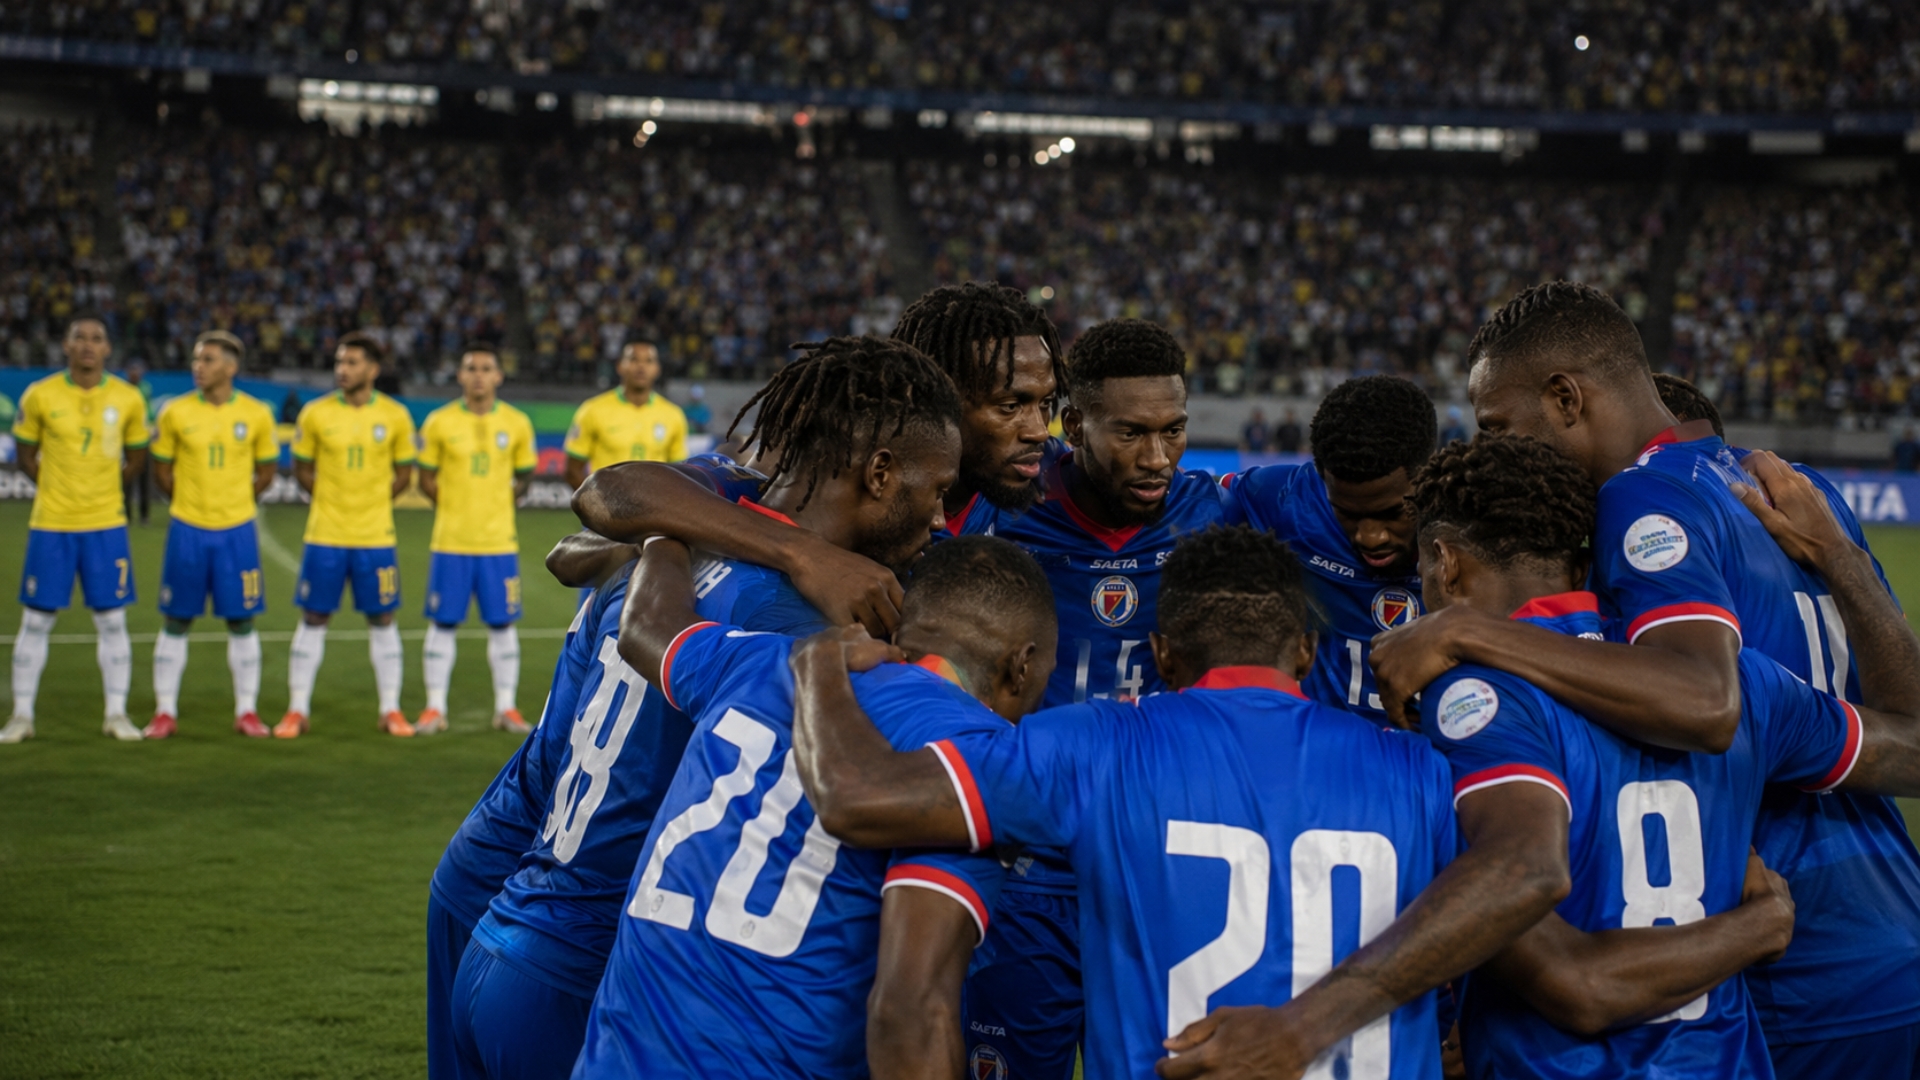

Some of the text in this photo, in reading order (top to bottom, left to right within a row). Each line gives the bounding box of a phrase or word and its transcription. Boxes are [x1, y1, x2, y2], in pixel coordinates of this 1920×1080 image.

[208, 444, 225, 469] 11
[1090, 559, 1138, 569] SAETA
[1309, 555, 1355, 578] SAETA
[627, 707, 842, 958] 20
[1616, 779, 1709, 1024] 8
[1166, 820, 1397, 1080] 20
[970, 1021, 1006, 1037] SAETA
